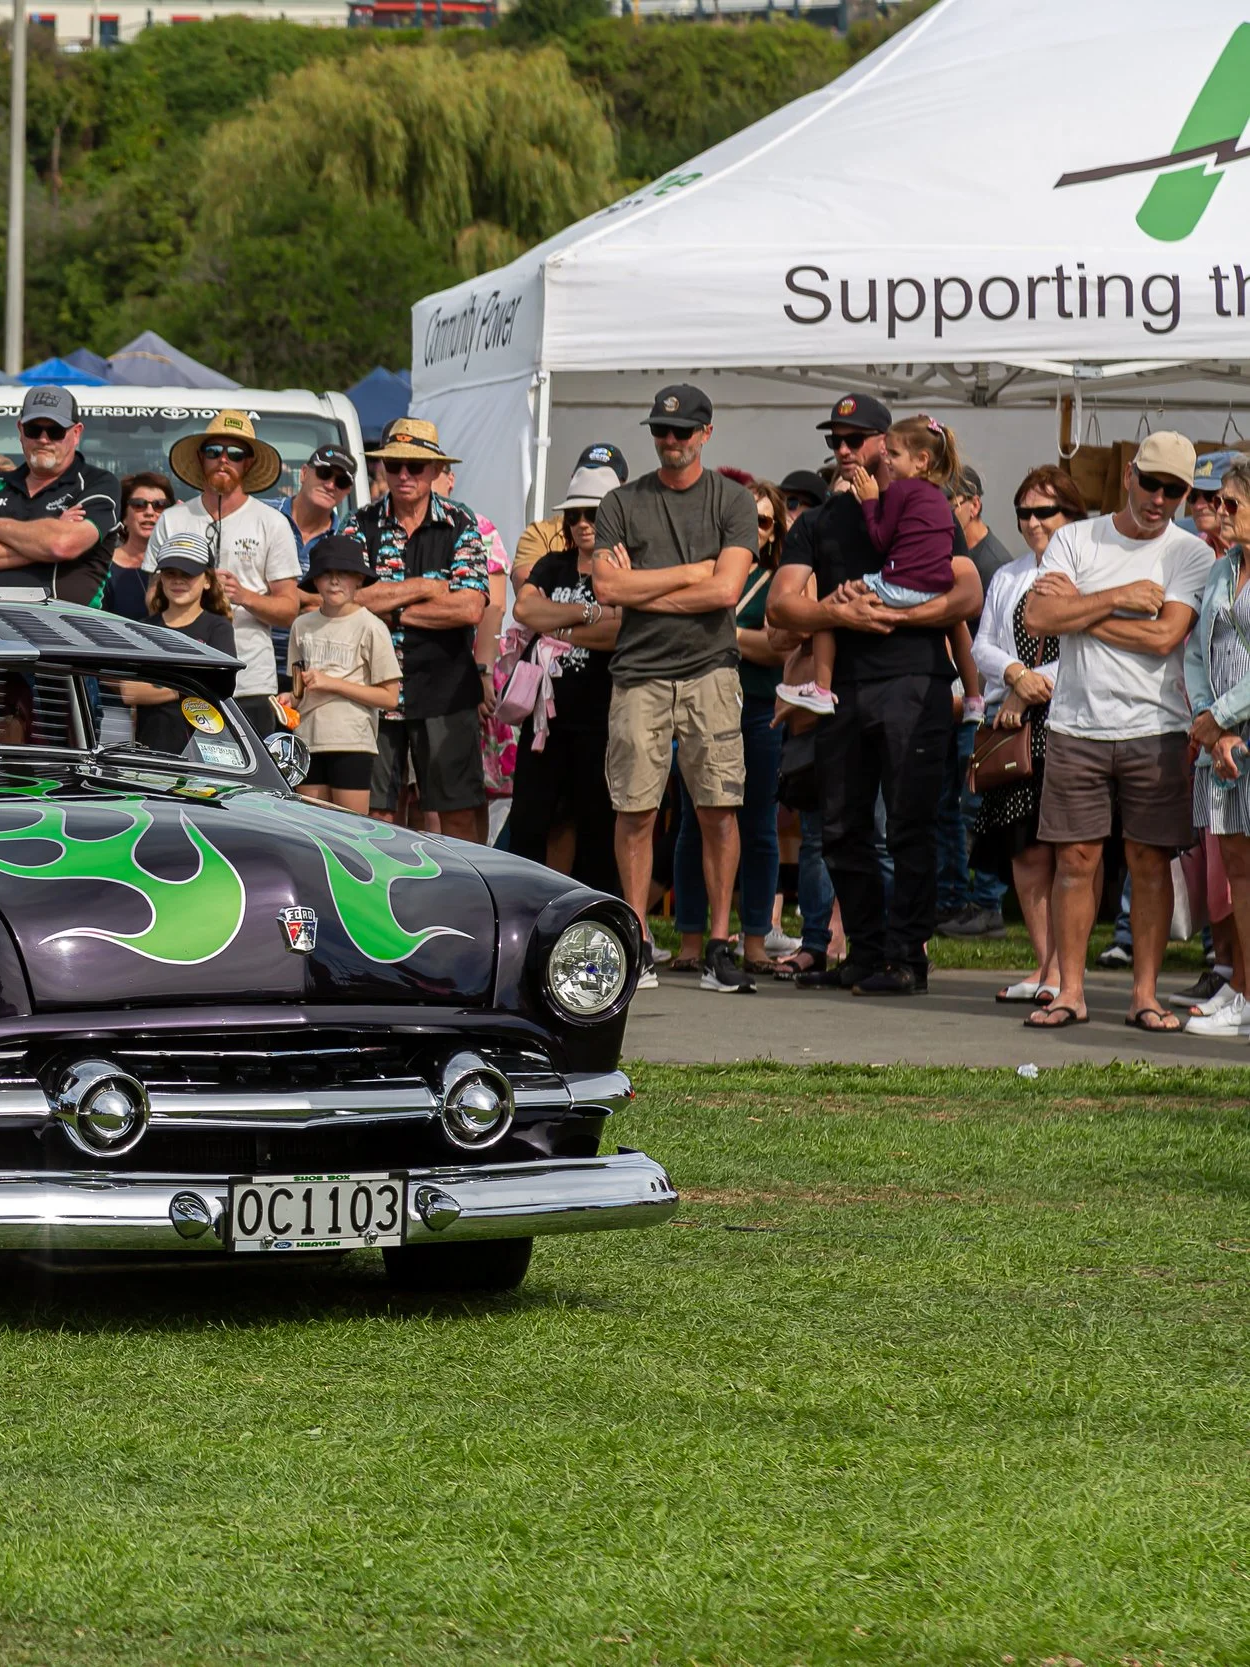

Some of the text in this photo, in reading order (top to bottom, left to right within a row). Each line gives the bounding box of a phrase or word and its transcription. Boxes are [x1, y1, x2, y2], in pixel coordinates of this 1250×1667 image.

[783, 261, 1181, 339] Supporting
[424, 290, 523, 372] Community Power
[287, 910, 313, 920] FORD
[237, 1183, 399, 1237] OC1103
[296, 1240, 341, 1248] HEAVEN
